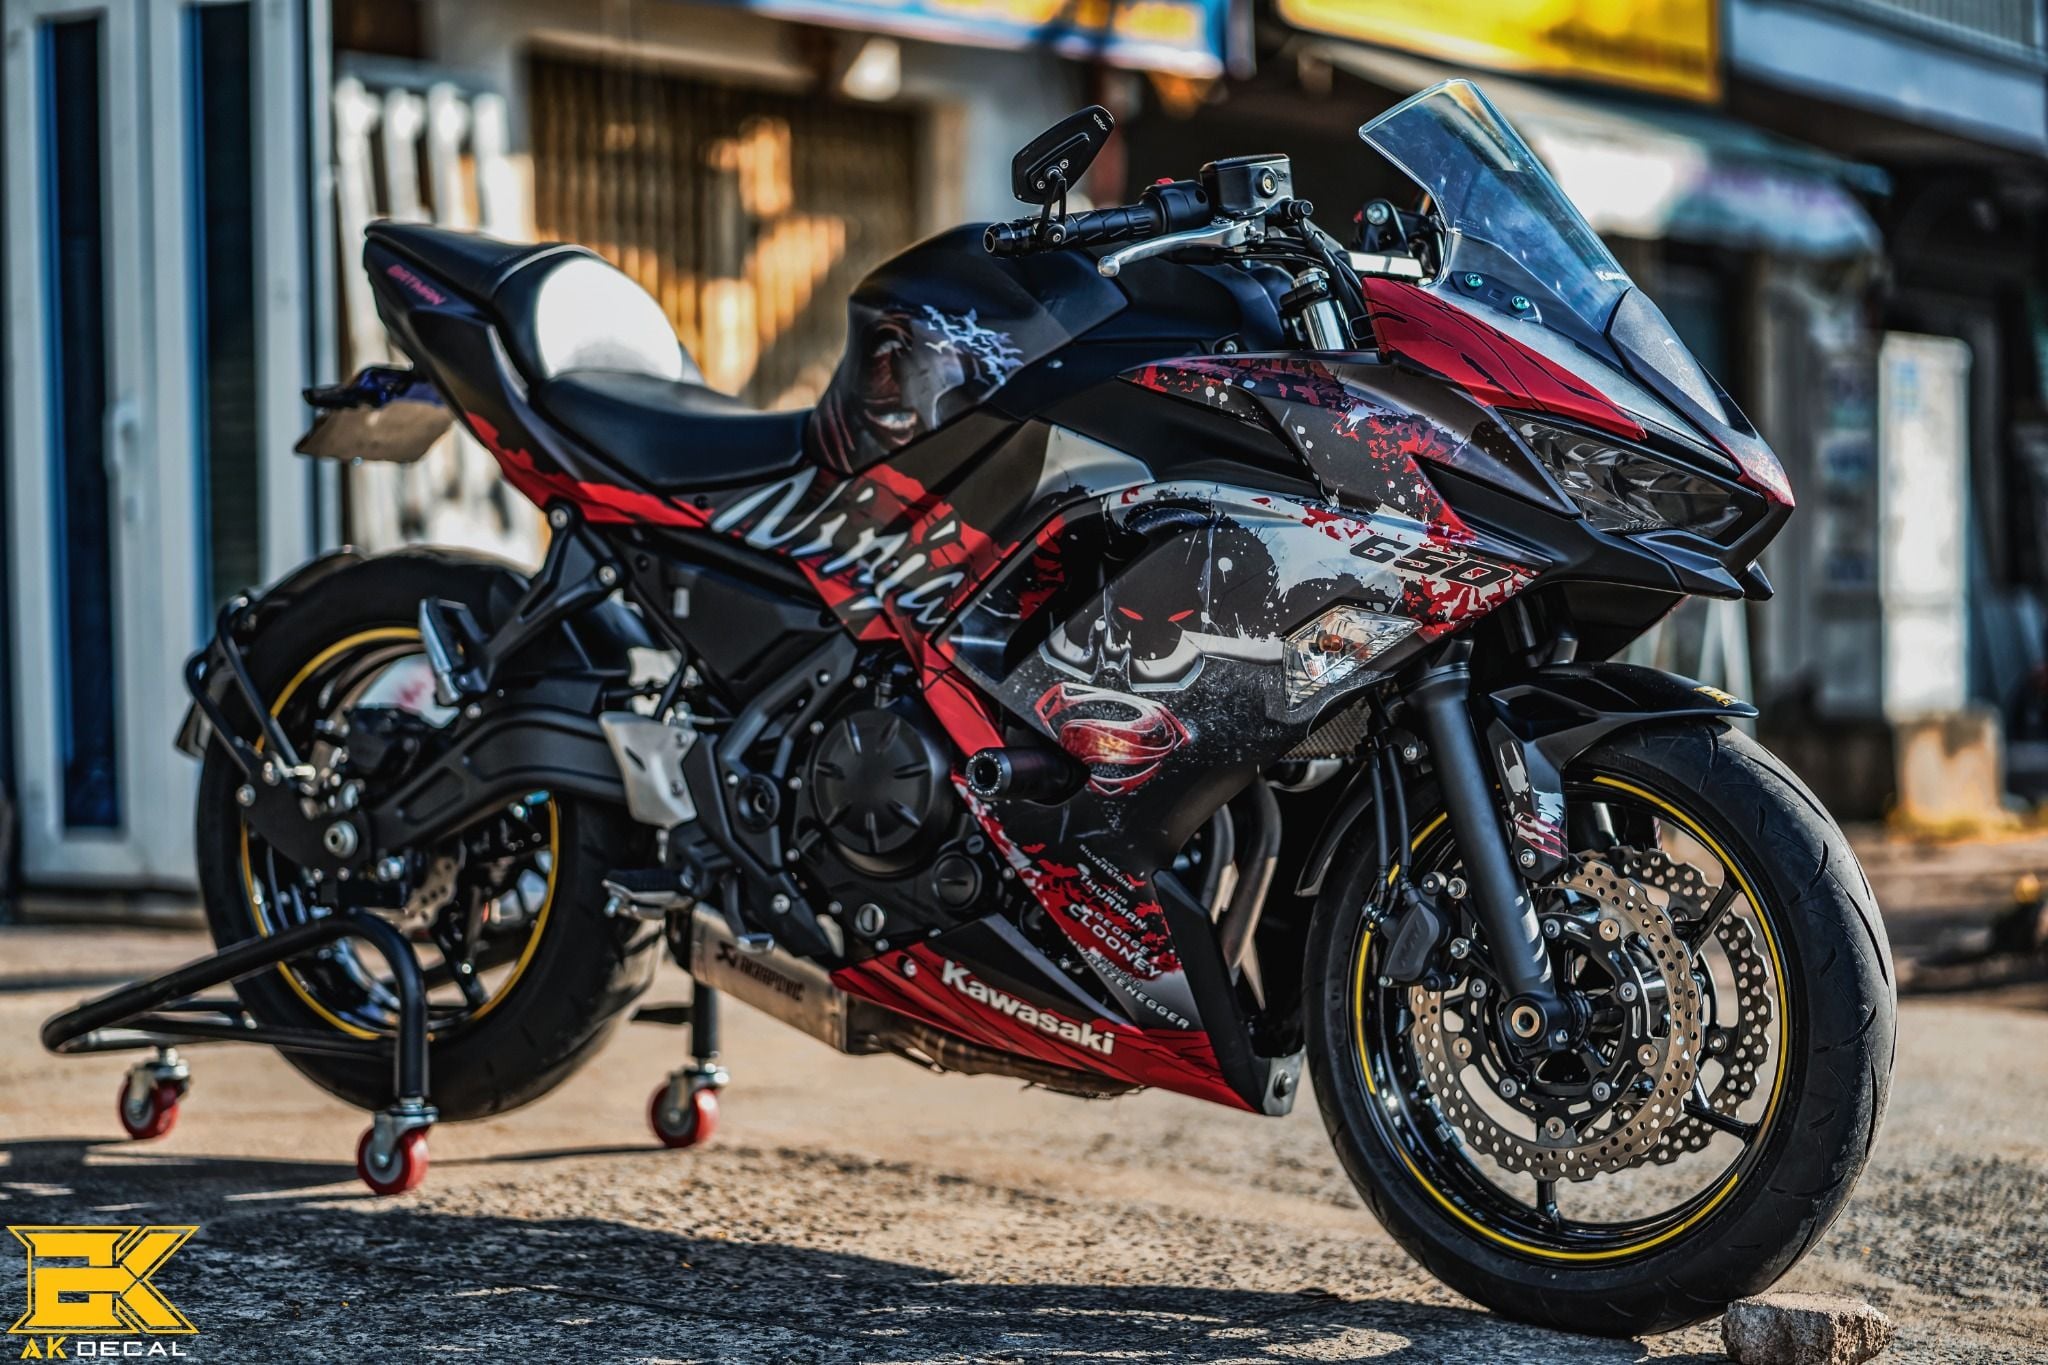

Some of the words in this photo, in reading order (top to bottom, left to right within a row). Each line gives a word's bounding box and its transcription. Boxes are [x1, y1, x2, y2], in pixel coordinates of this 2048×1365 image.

[711, 465, 966, 626] Ninja
[1349, 535, 1513, 589] 650
[1079, 844, 1137, 893] SILVERSTONE
[1079, 874, 1147, 930] THURMAN
[1069, 903, 1161, 977] CLOONEY
[1094, 911, 1150, 955] GEORGE
[942, 959, 1115, 1055] Kawasaki
